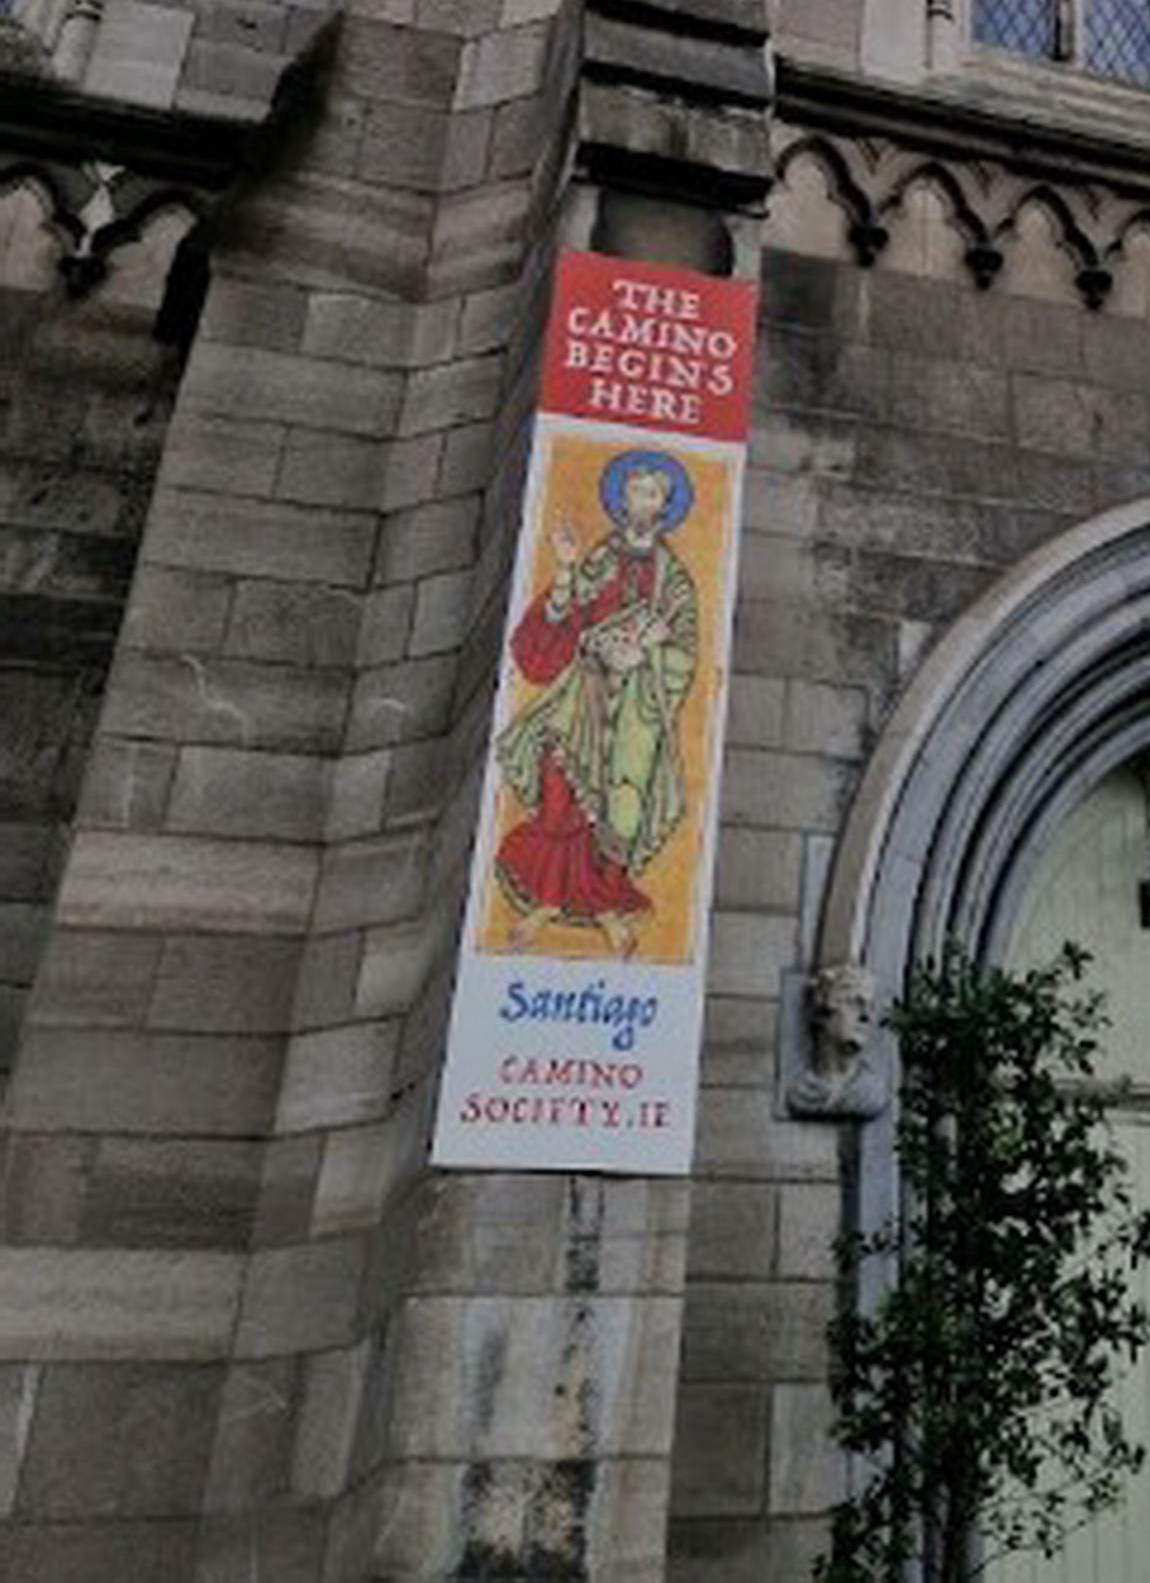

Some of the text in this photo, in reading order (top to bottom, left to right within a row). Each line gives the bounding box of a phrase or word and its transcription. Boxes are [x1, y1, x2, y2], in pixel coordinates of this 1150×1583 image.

[612, 278, 701, 318] THE
[566, 307, 737, 360] CAMINO
[564, 337, 734, 396] BEGINS
[588, 379, 703, 424] HERE
[499, 980, 658, 1051] Santiago
[498, 1055, 644, 1090] CAMINO
